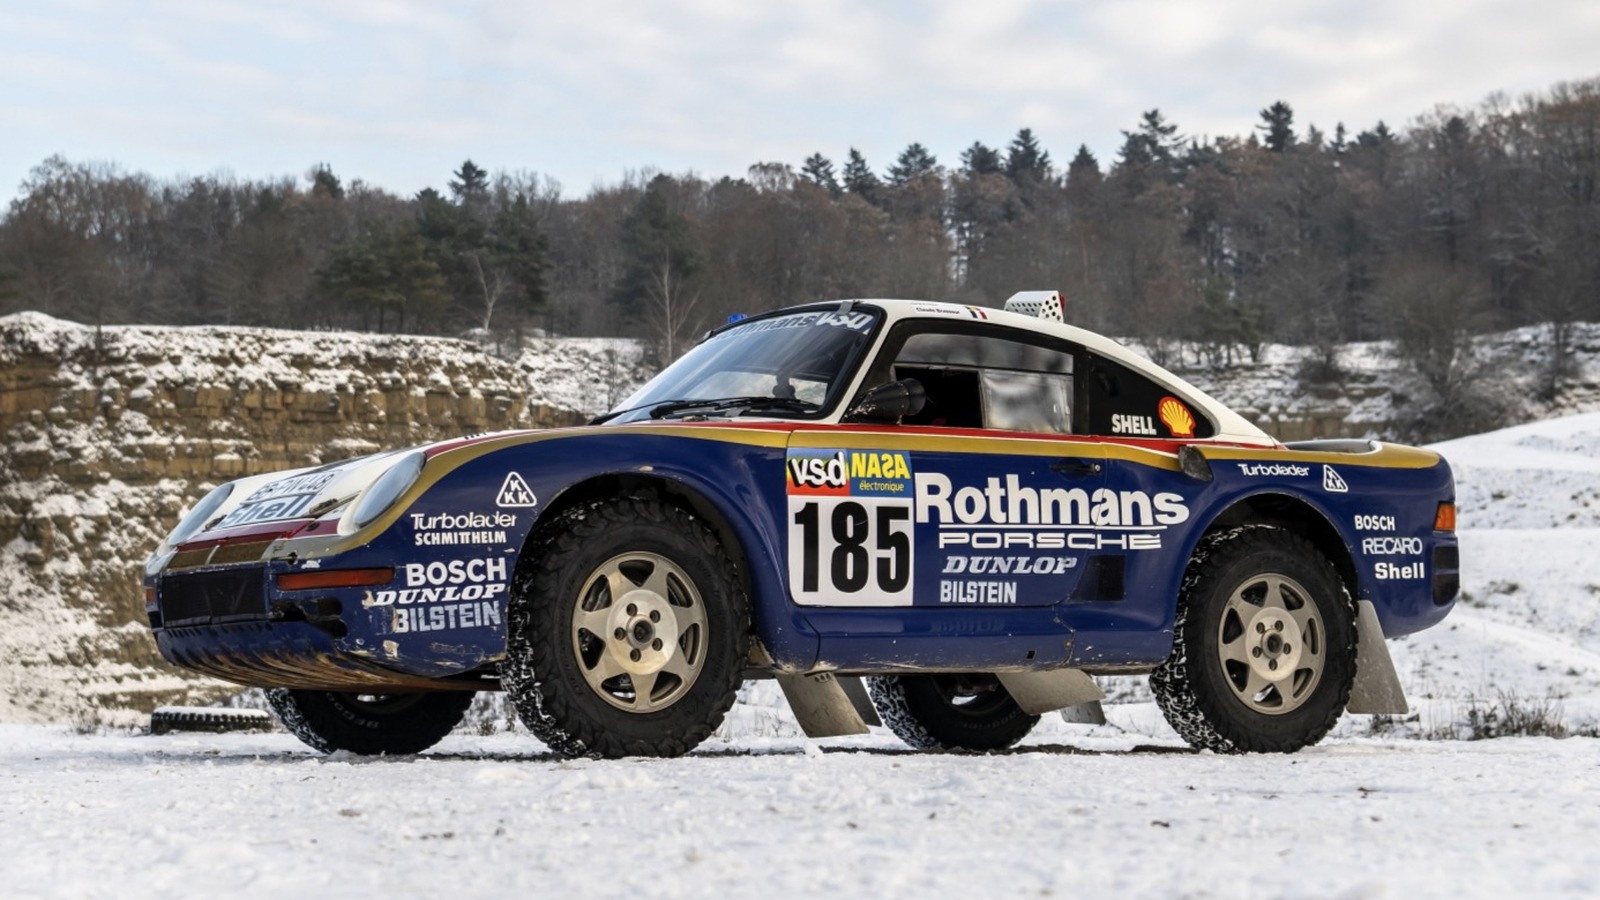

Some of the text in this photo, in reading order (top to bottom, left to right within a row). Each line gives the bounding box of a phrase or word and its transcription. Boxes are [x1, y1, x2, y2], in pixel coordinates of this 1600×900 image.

[1111, 413, 1157, 435] SHELL
[852, 452, 911, 479] NASA
[1238, 463, 1310, 477] Turbolader
[859, 480, 904, 493] électronique
[914, 472, 1190, 526] Rothmans
[410, 511, 517, 530] Turbolader
[1354, 515, 1396, 531] BOSCH
[415, 531, 507, 546] SCHMITTHELM
[795, 501, 910, 593] 185
[938, 532, 1162, 550] PORSCHE
[1362, 537, 1423, 555] RECARO
[406, 557, 507, 586] BOSCH
[941, 555, 1077, 575] DUNLOP
[1374, 562, 1425, 579] Shell
[374, 584, 506, 605] DUNLOP
[940, 580, 1017, 603] BILSTEIN
[395, 601, 501, 633] BILSTEIN
